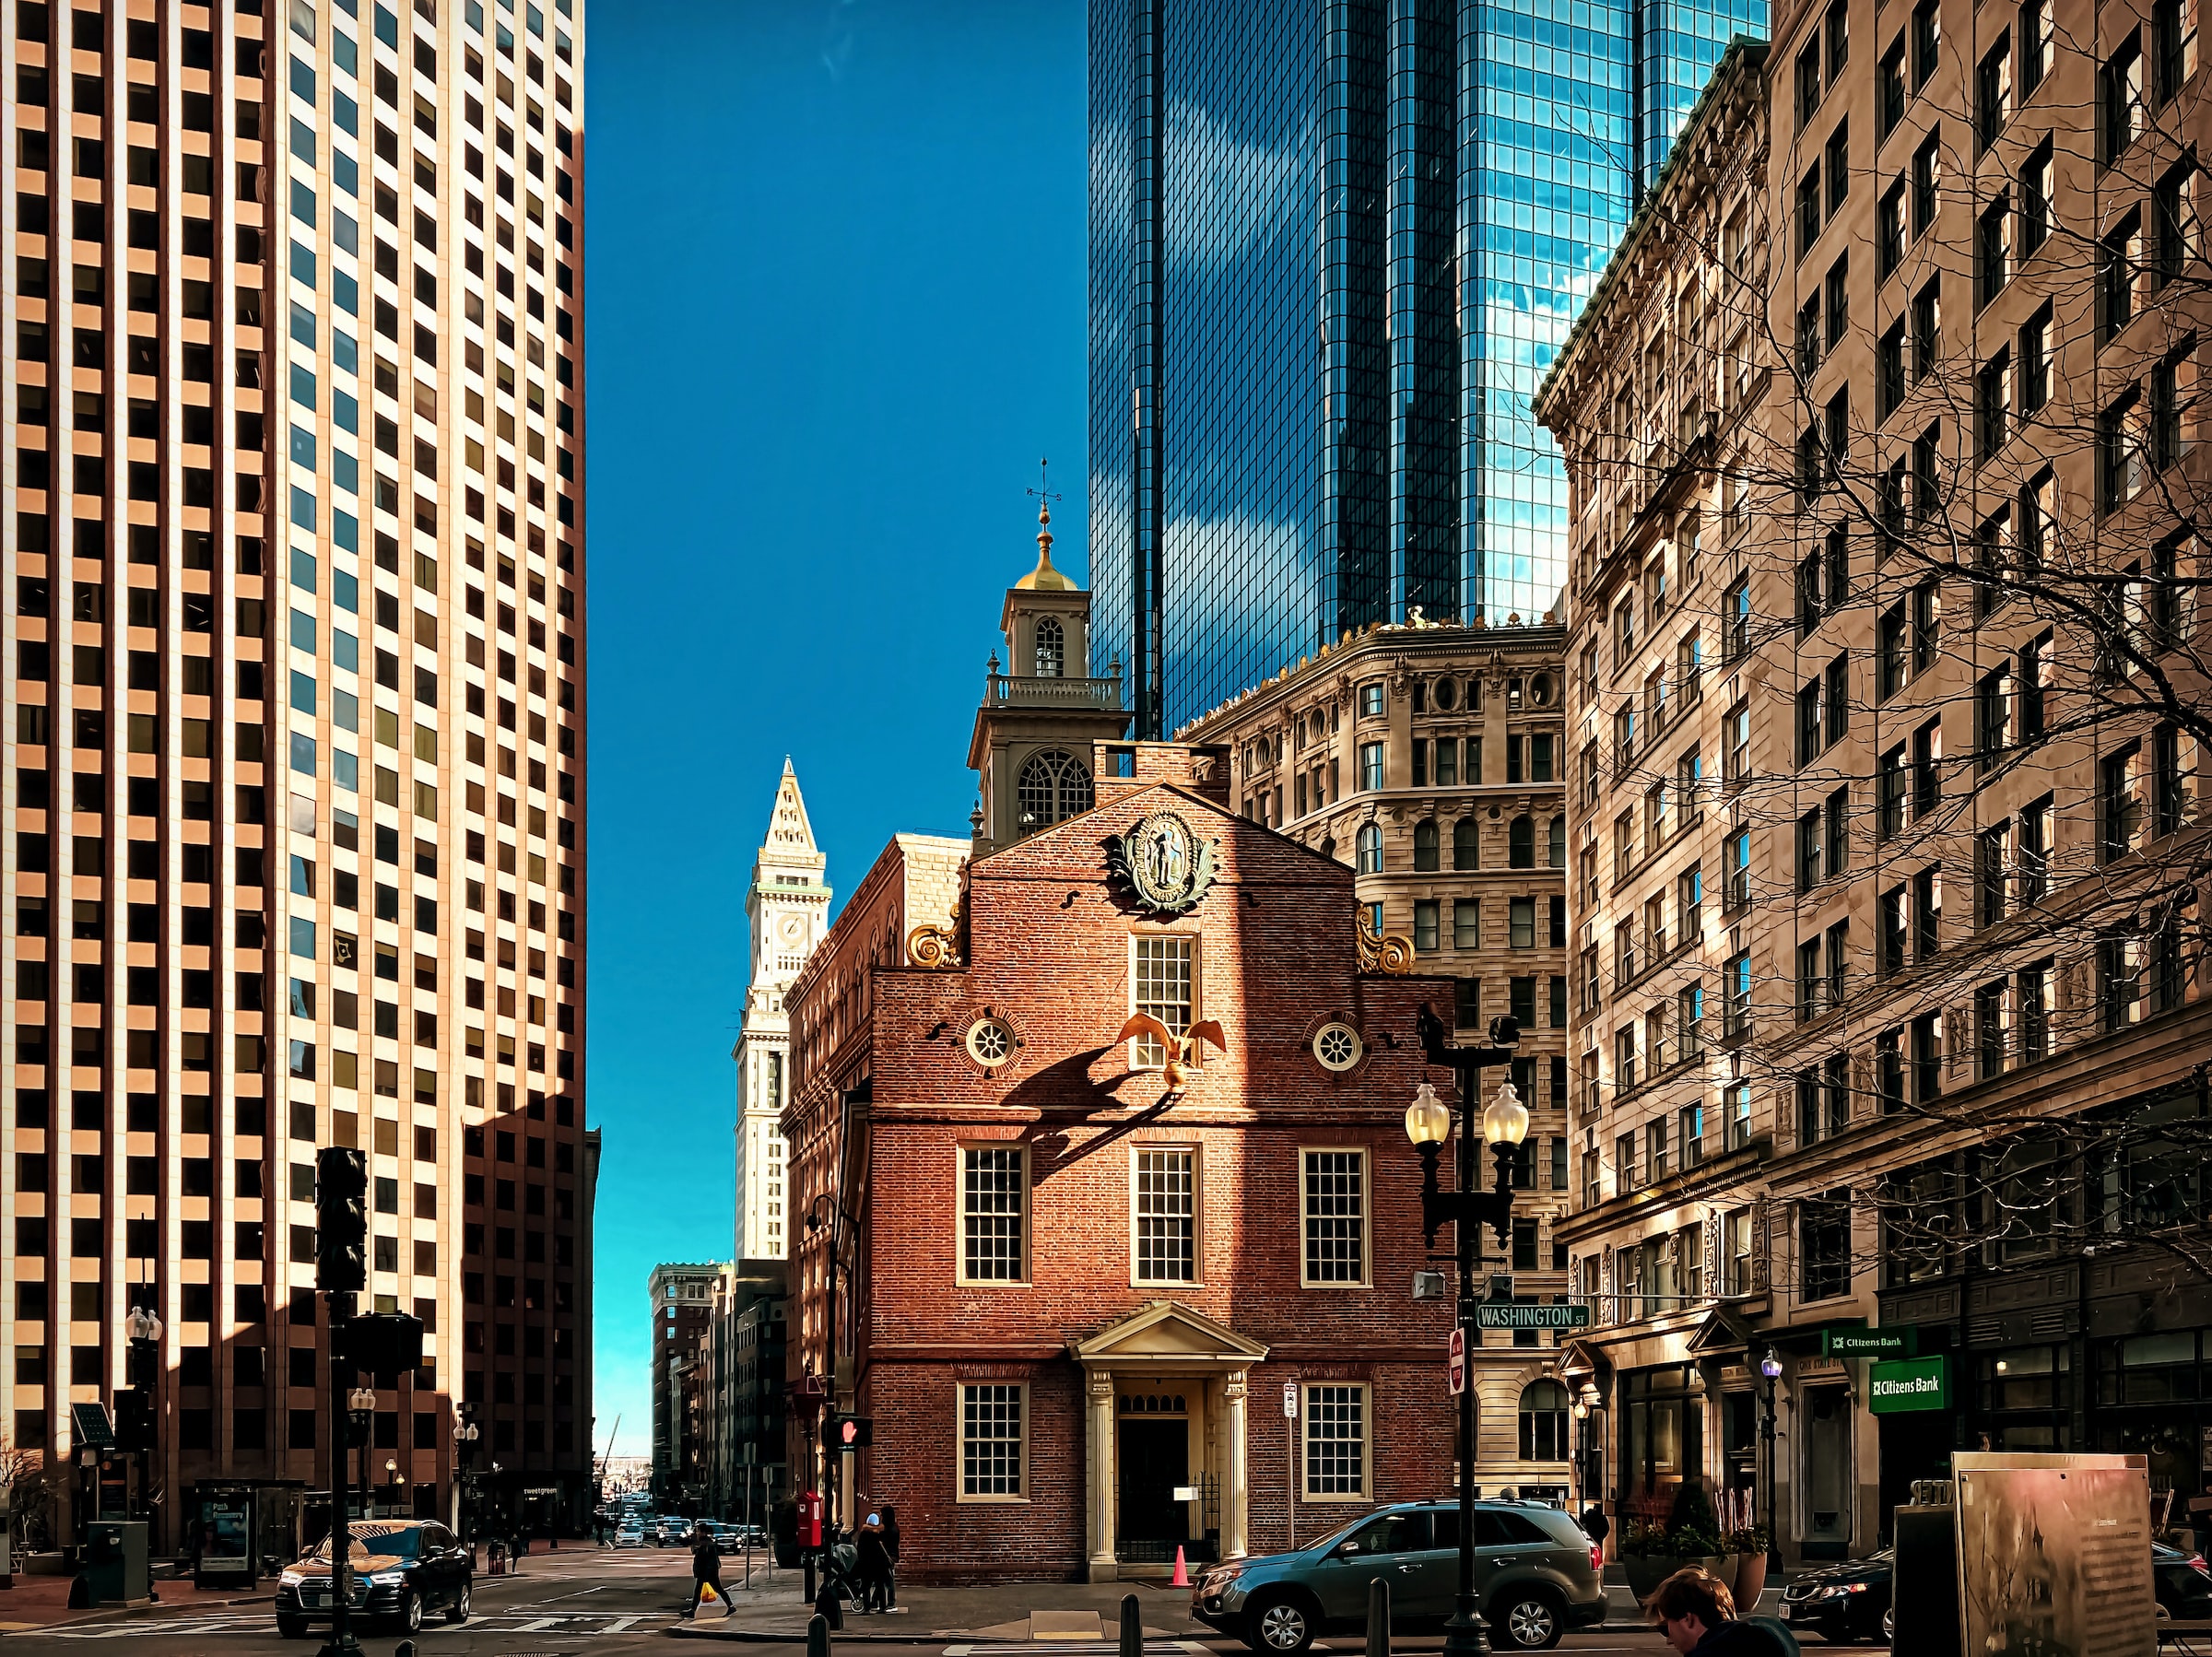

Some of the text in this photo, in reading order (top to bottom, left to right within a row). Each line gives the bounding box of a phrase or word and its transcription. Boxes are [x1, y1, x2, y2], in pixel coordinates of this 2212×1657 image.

[1481, 1308, 1585, 1325] WASHINGTON ST
[1846, 1337, 1902, 1347] Citizens Bank
[1880, 1375, 1939, 1395] Citizens Bank
[524, 1487, 558, 1496] sweetgreen
